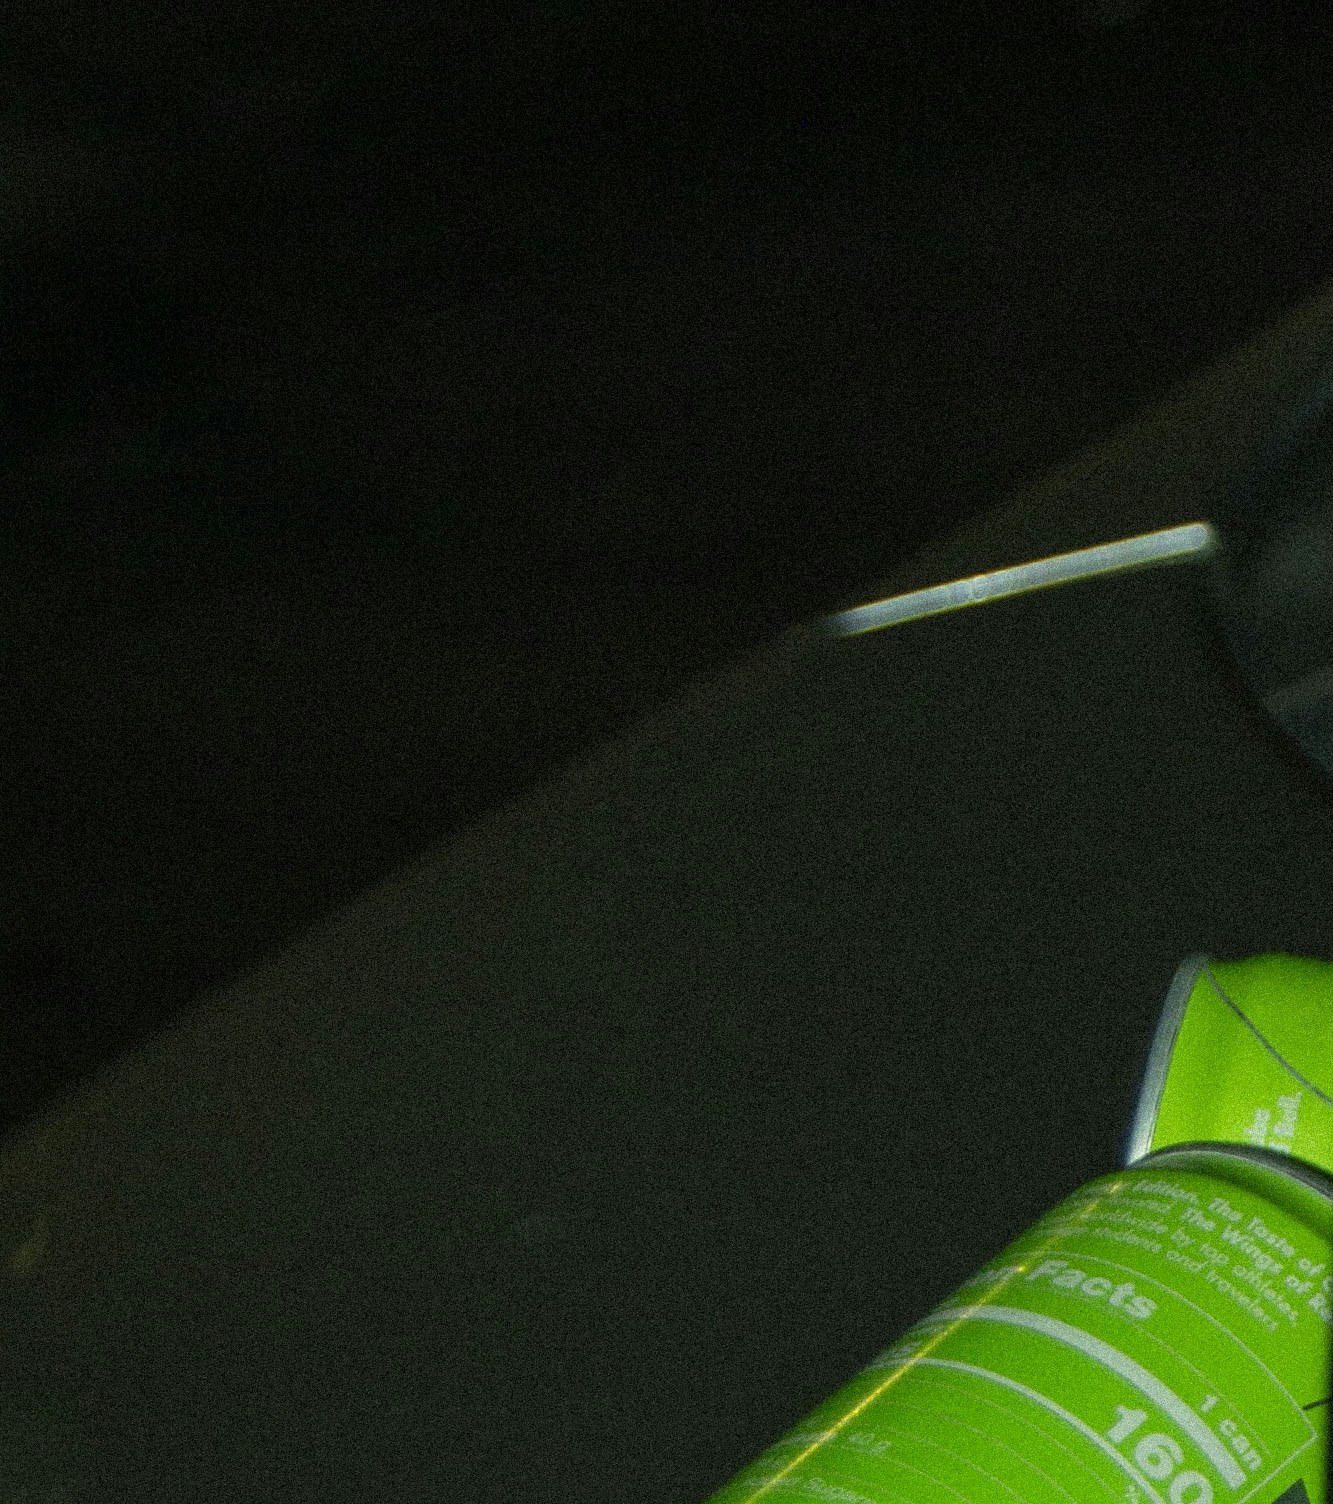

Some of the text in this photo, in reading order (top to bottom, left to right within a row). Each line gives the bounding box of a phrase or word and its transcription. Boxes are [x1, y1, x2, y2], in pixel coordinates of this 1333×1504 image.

[1180, 1206, 1312, 1296] The Wings of
[1195, 1240, 1231, 1270] top
[1207, 1195, 1243, 1224] The
[1246, 1216, 1298, 1259] Taste
[1295, 1251, 1324, 1278] of
[1025, 1259, 1155, 1321] Facts
[1197, 1393, 1267, 1472] 1 can
